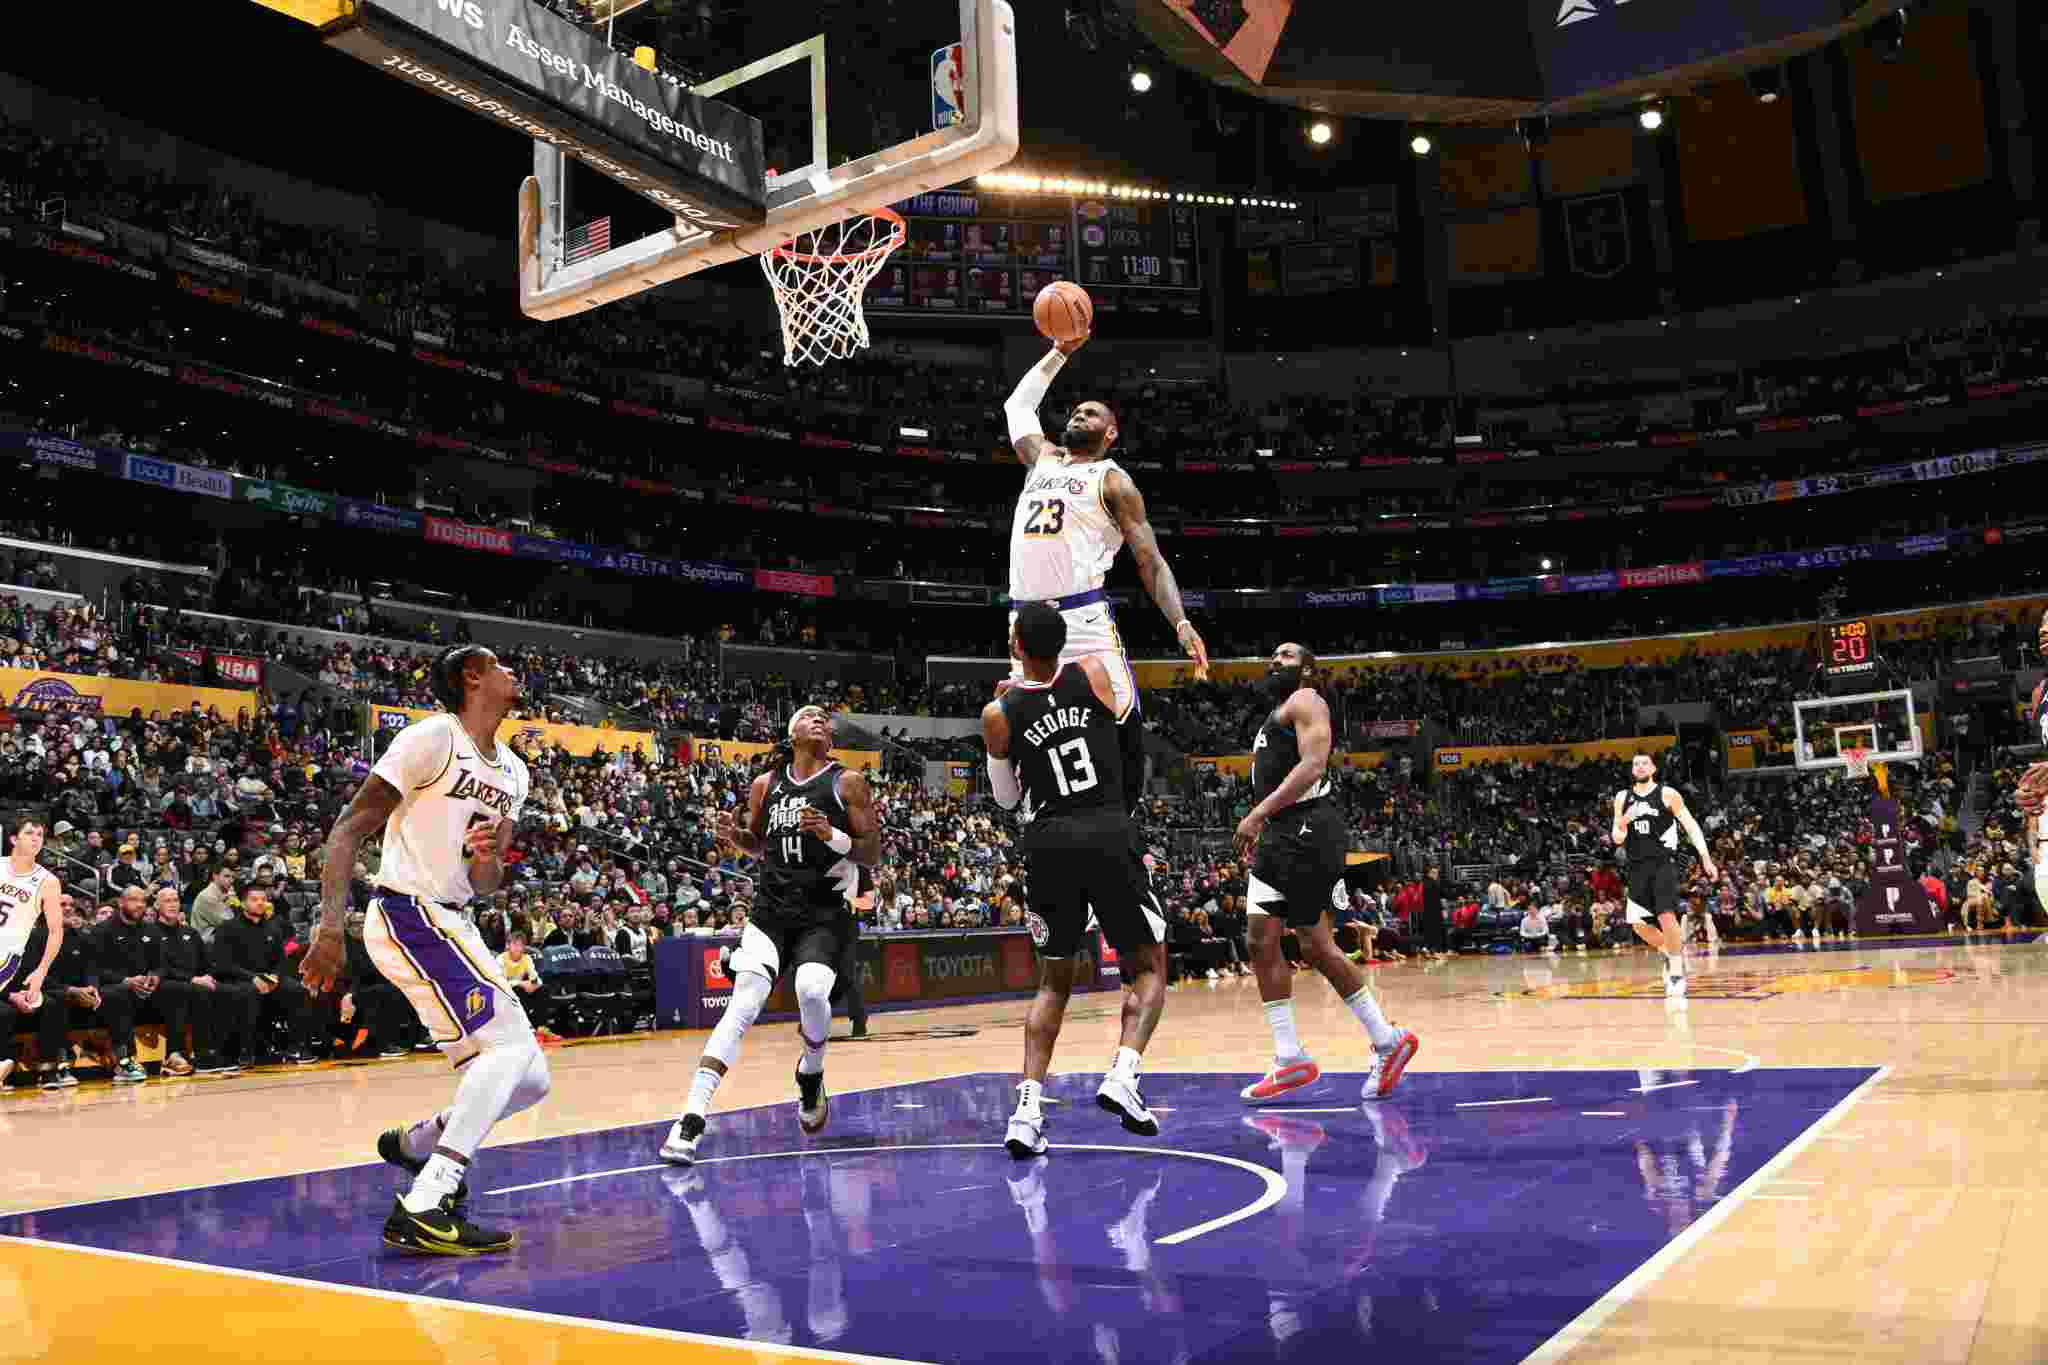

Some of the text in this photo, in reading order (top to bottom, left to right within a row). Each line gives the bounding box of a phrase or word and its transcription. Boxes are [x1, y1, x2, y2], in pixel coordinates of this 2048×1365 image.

[506, 24, 578, 80] Asset
[583, 63, 733, 163] Management
[1024, 498, 1064, 534] 23
[1832, 639, 1866, 661] 20
[1024, 707, 1091, 746] GEORGE
[1048, 737, 1098, 796] 13
[445, 768, 513, 817] LAKERS
[782, 836, 804, 863] 14
